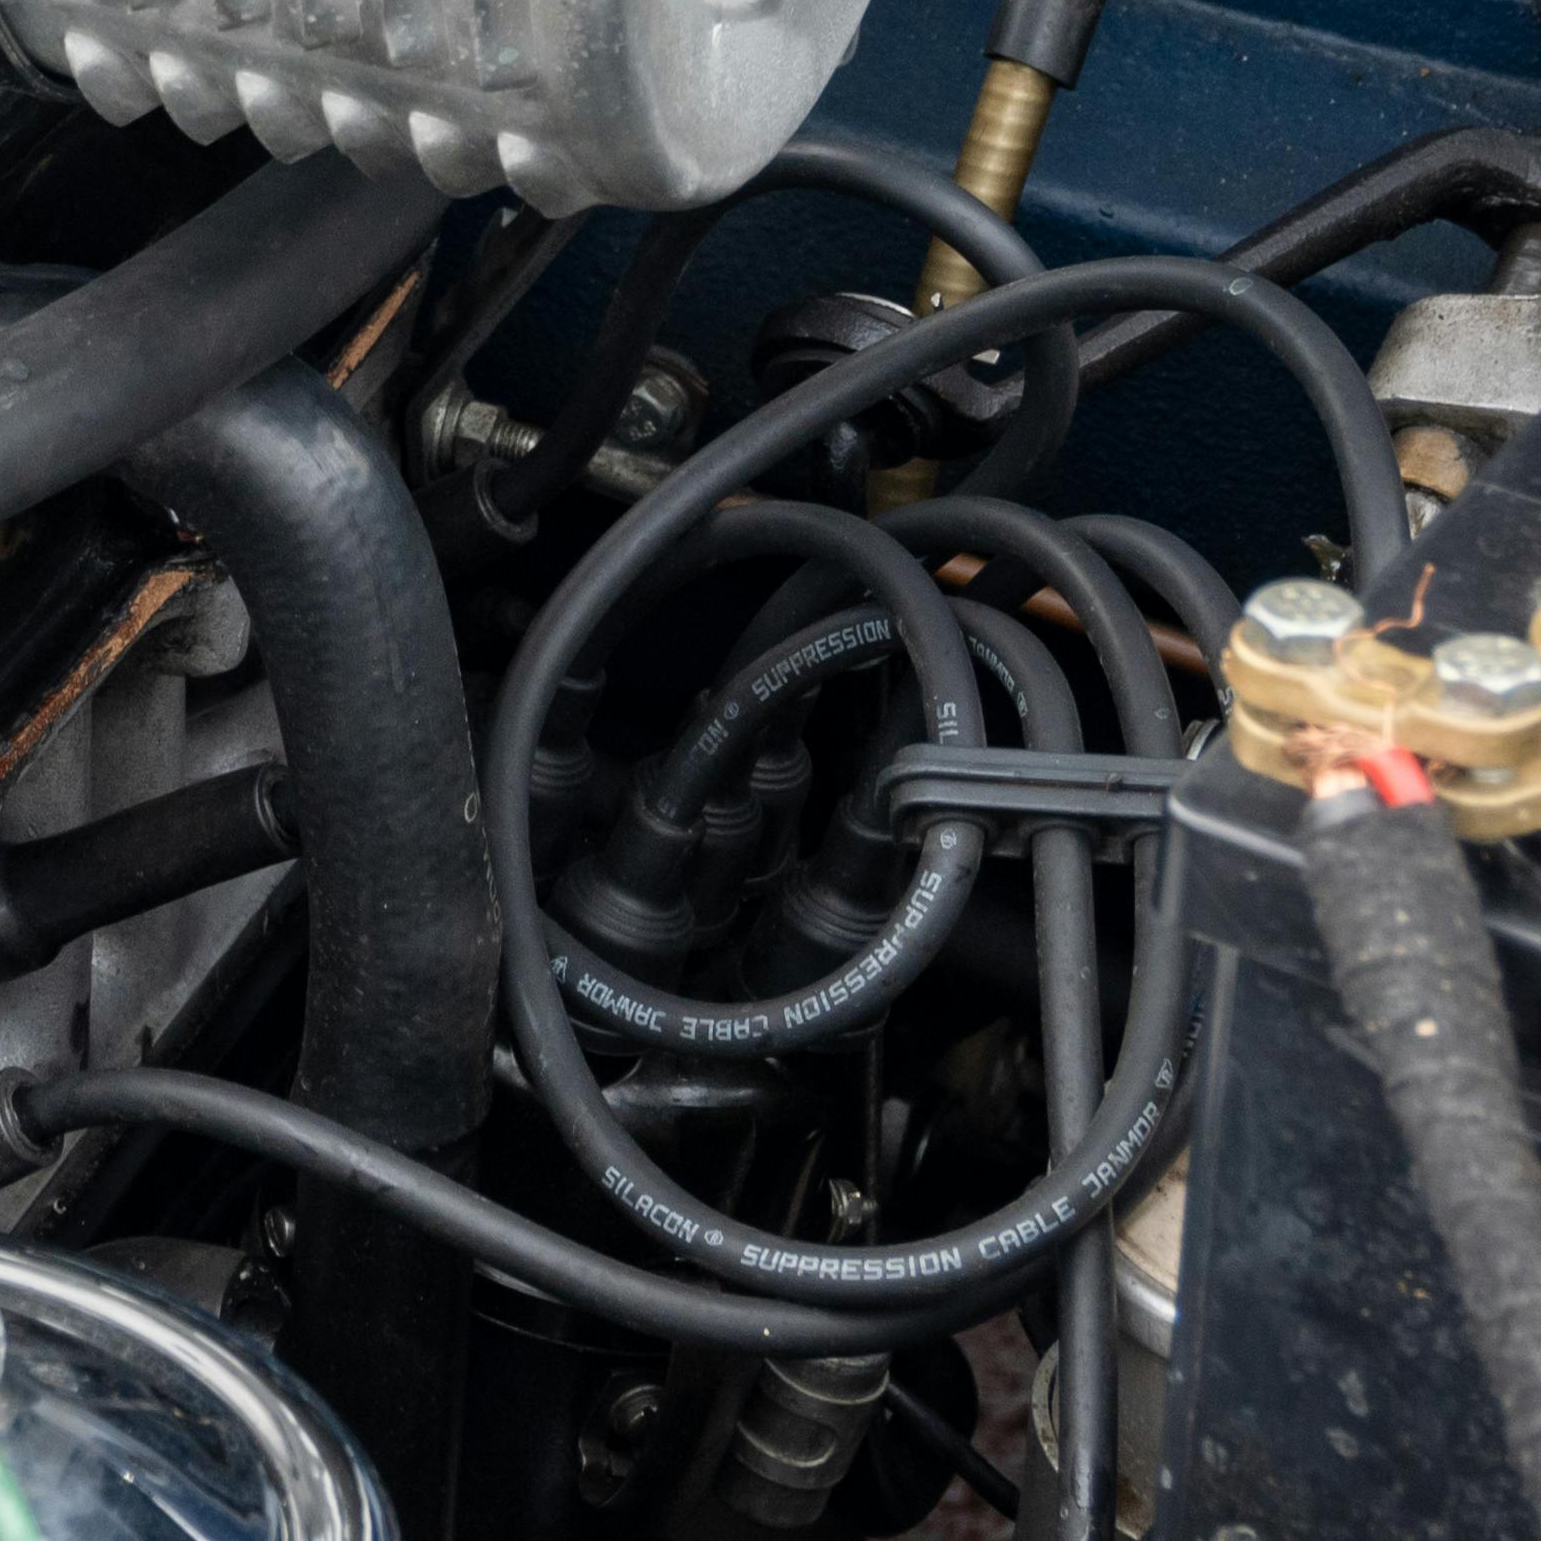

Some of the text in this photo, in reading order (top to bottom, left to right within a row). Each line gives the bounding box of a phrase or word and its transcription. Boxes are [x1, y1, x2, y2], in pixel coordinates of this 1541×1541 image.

[751, 618, 892, 703] SUPPRESSION
[576, 973, 667, 1033] JANMOR
[679, 1014, 769, 1042] CABLE
[601, 1101, 1161, 1281] SILACON SUPPRESSION CABLE JANMOR
